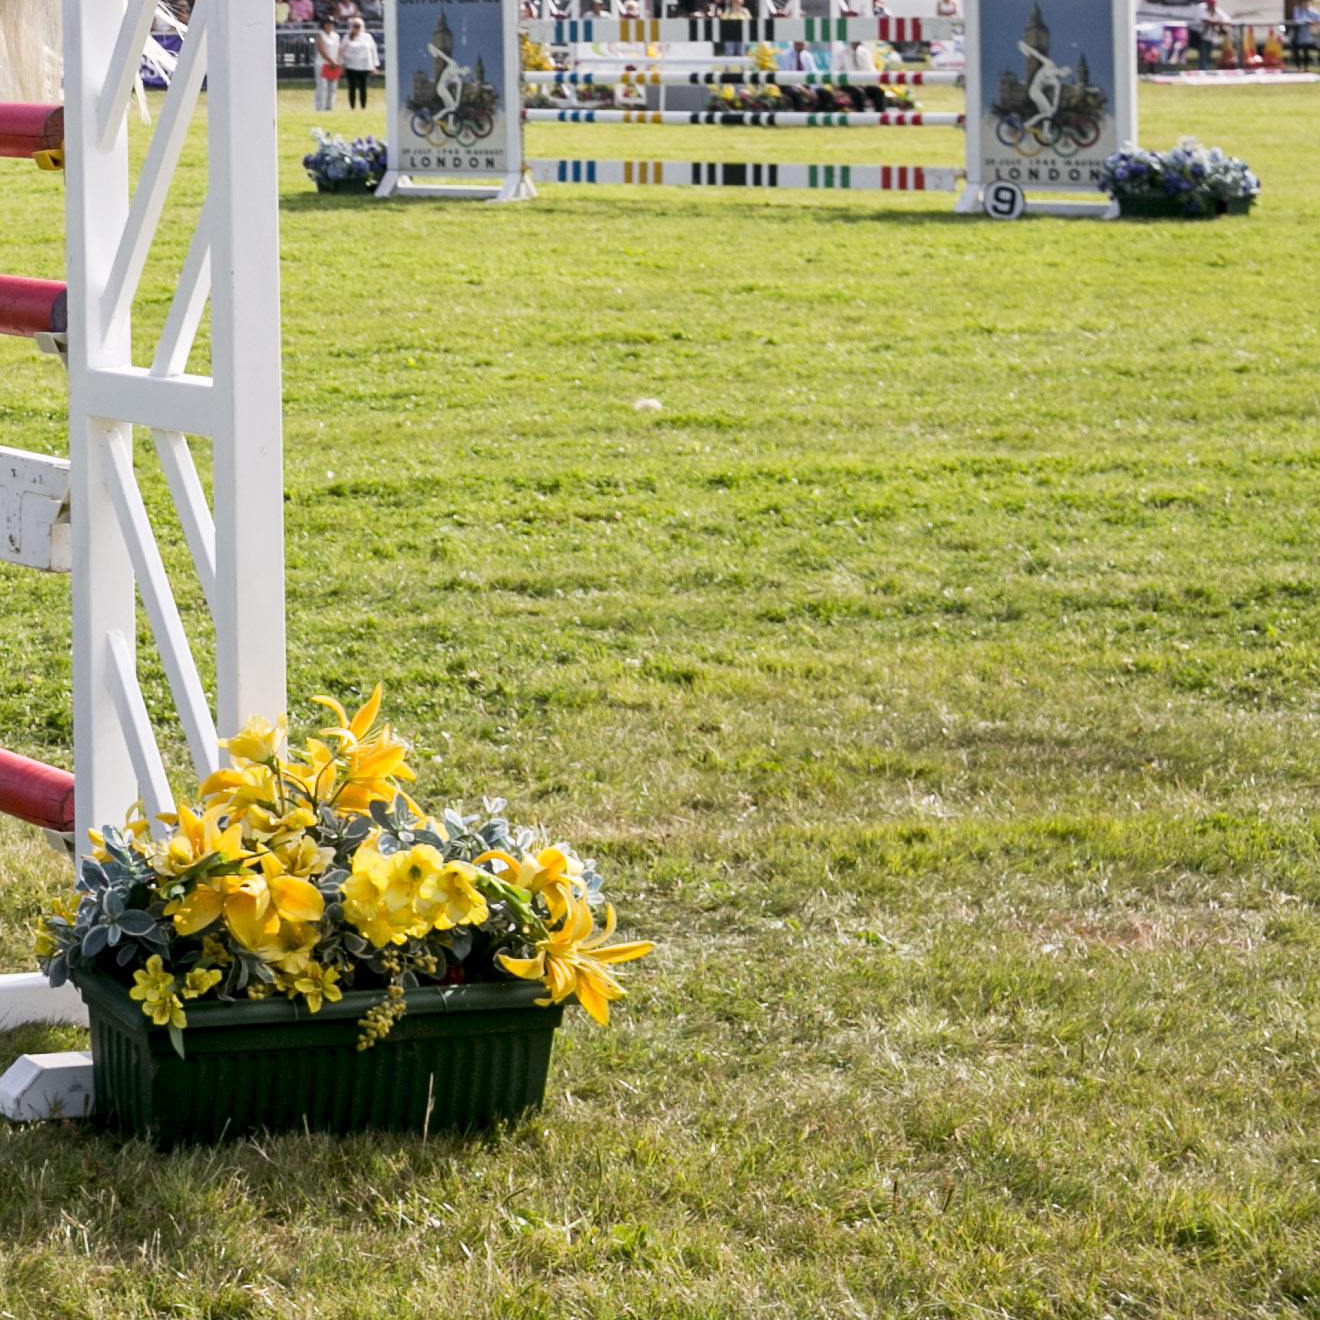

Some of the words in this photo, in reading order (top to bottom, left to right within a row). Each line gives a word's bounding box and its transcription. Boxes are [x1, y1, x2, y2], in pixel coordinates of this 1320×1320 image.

[410, 156, 495, 168] LONDON
[995, 167, 1100, 181] LONDON
[991, 186, 1017, 216] 9
